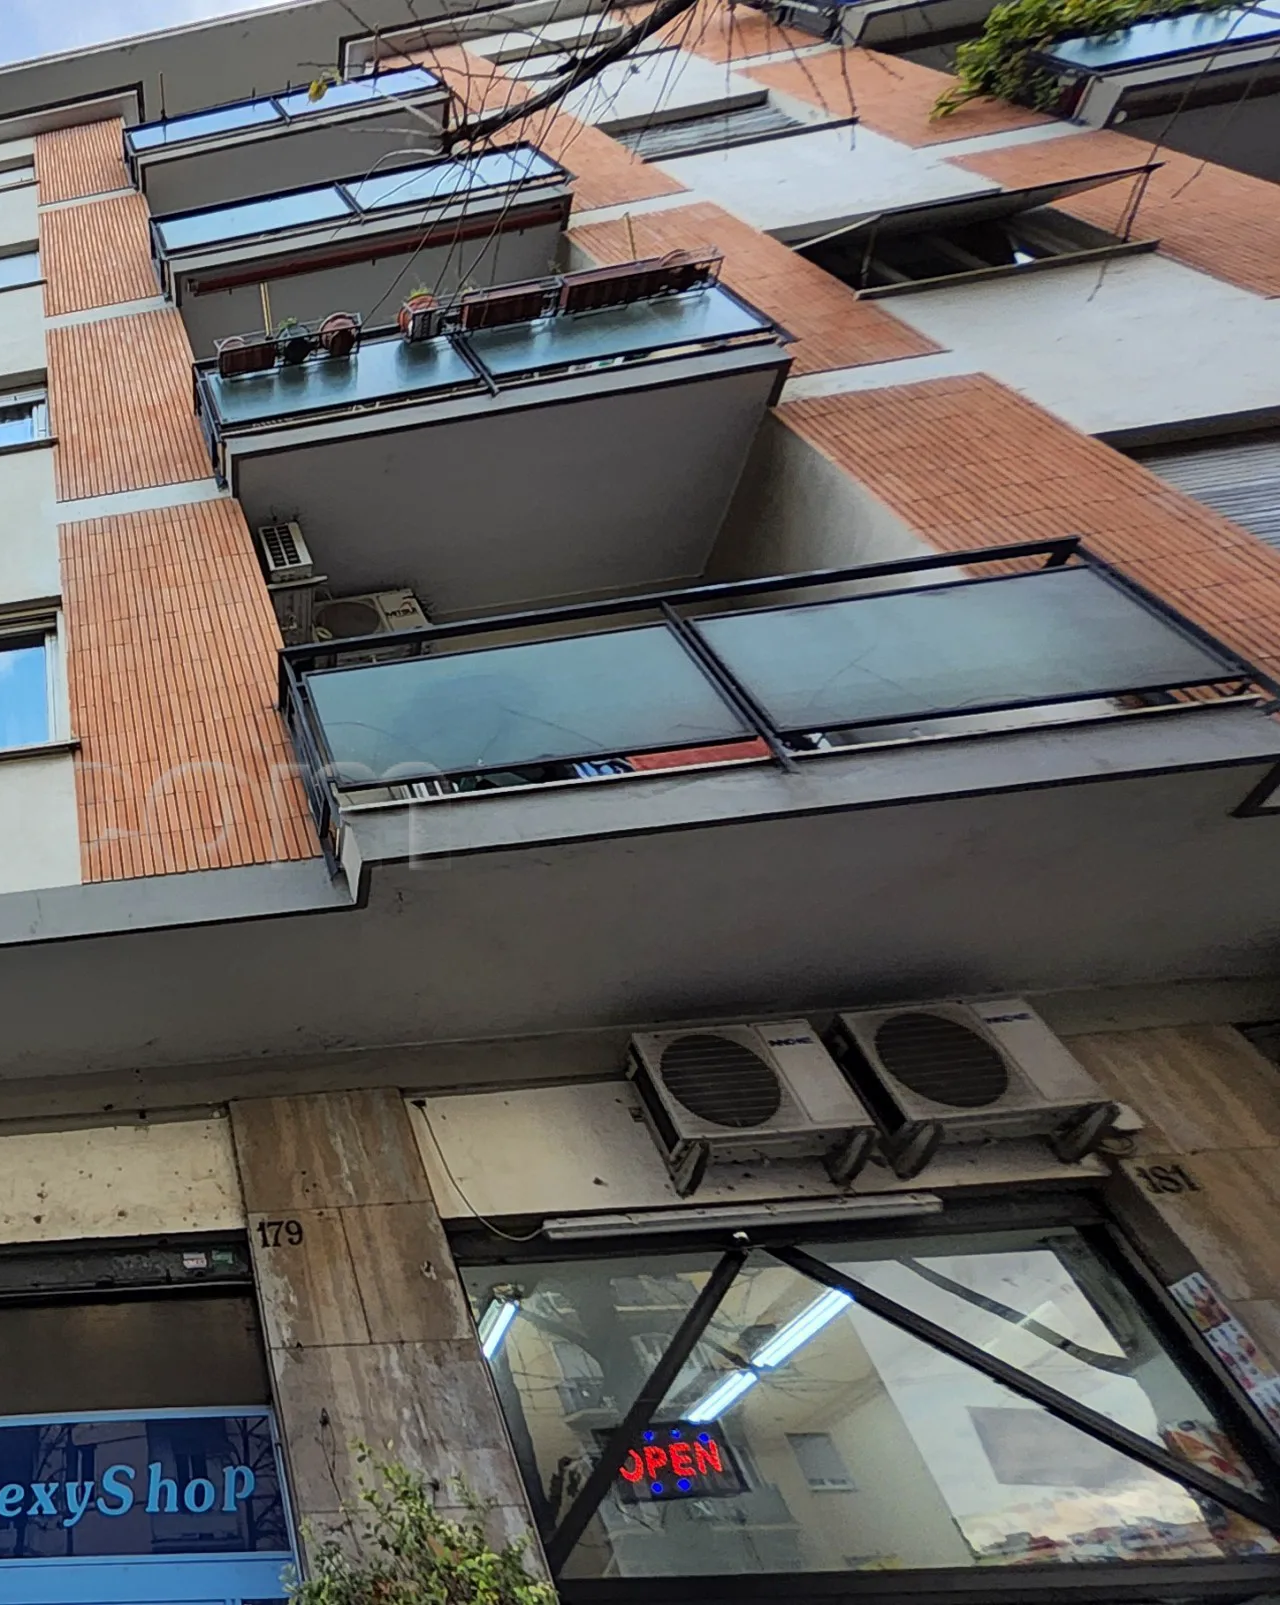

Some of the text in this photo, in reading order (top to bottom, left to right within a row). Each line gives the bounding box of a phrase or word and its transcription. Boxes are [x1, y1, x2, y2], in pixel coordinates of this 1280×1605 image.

[1135, 1165, 1201, 1194] 181
[257, 1218, 303, 1248] 179
[619, 1439, 723, 1483] OPEN
